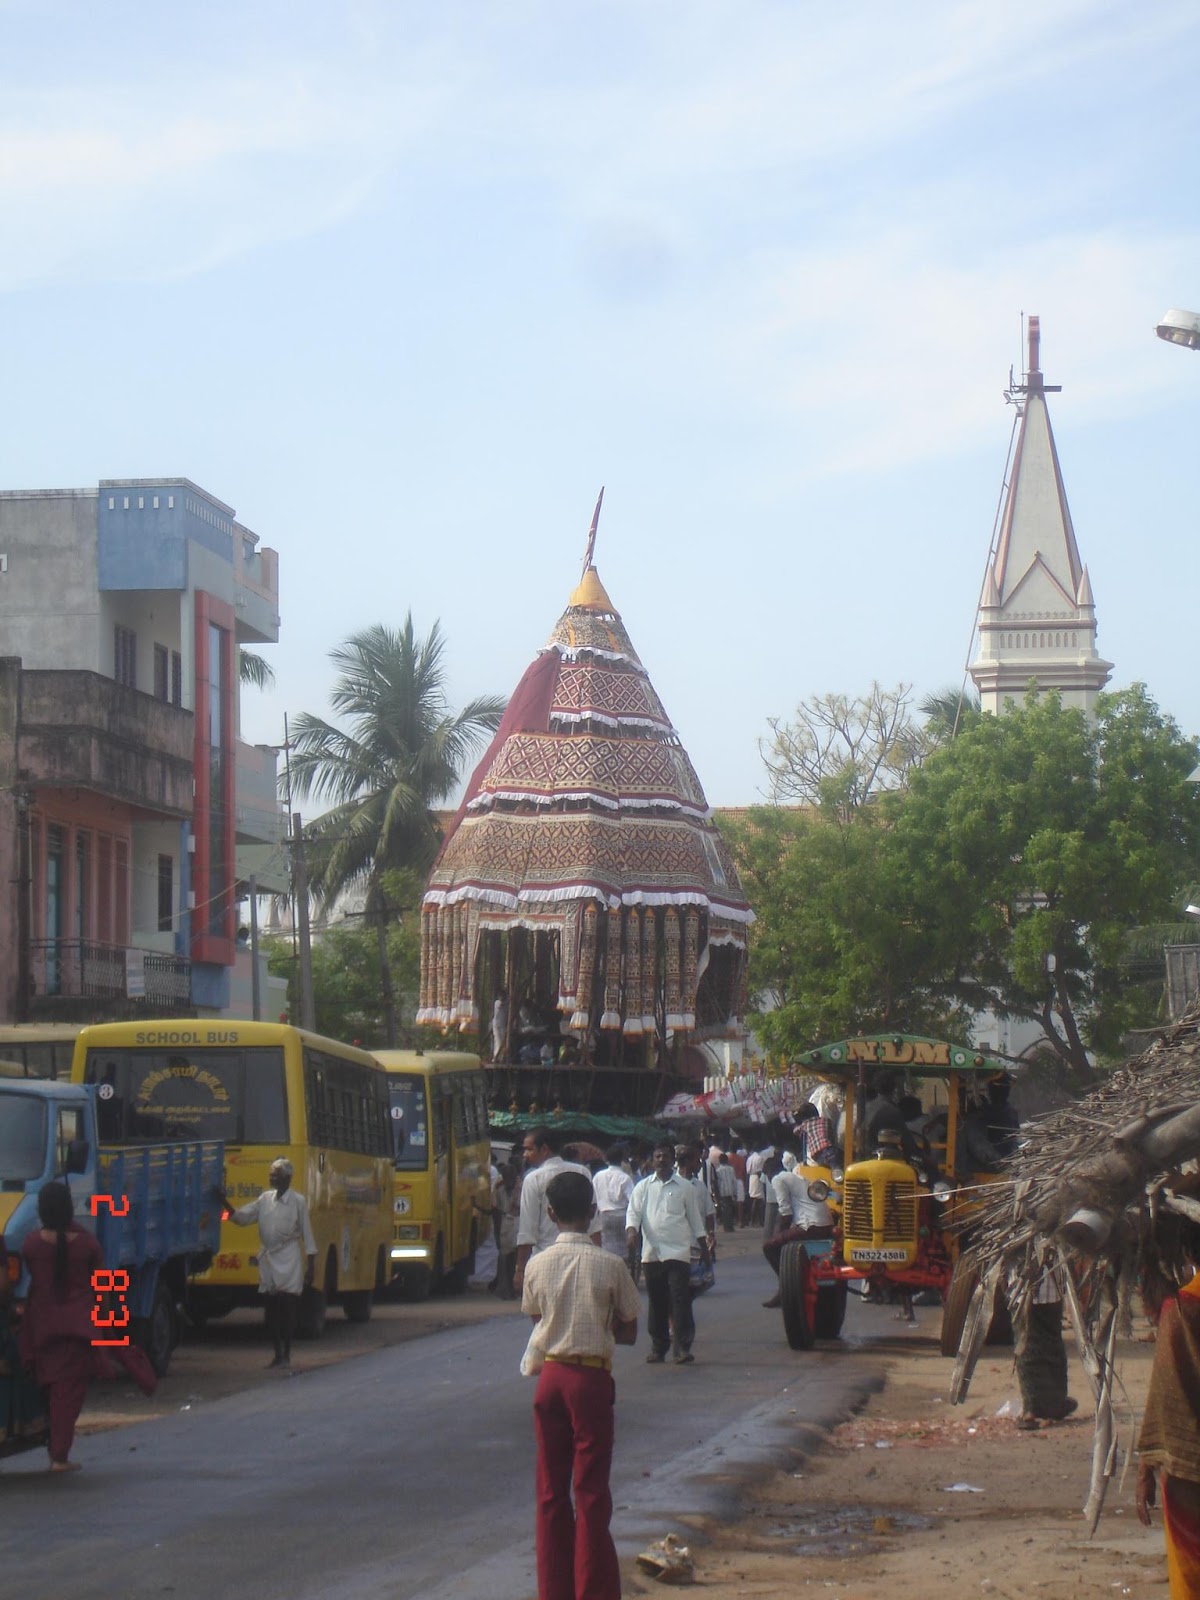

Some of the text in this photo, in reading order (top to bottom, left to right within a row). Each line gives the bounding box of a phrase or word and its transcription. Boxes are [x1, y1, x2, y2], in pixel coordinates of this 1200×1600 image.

[135, 1031, 238, 1044] SCHOOL BUS
[846, 1041, 950, 1065] NDM
